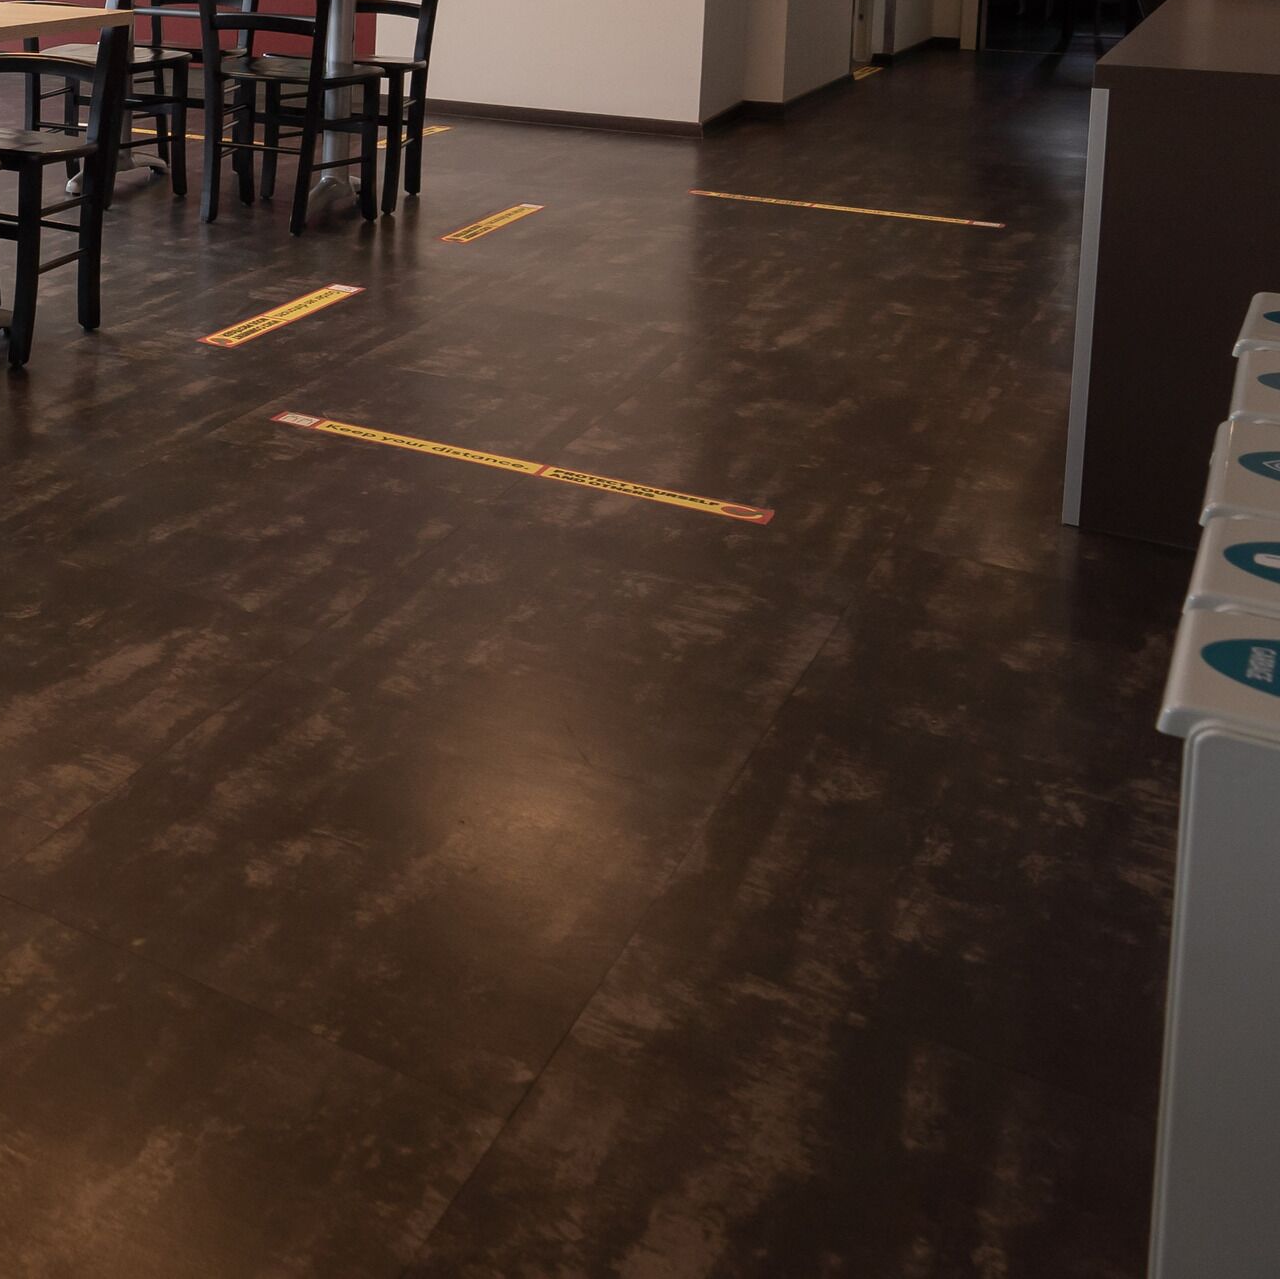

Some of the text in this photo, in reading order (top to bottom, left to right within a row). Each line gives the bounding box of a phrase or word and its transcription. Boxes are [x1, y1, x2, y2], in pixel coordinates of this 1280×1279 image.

[326, 423, 529, 470] Keep your distance.
[549, 473, 655, 498] AND OTHERS
[553, 469, 720, 506] PROTECT YOURSELF
